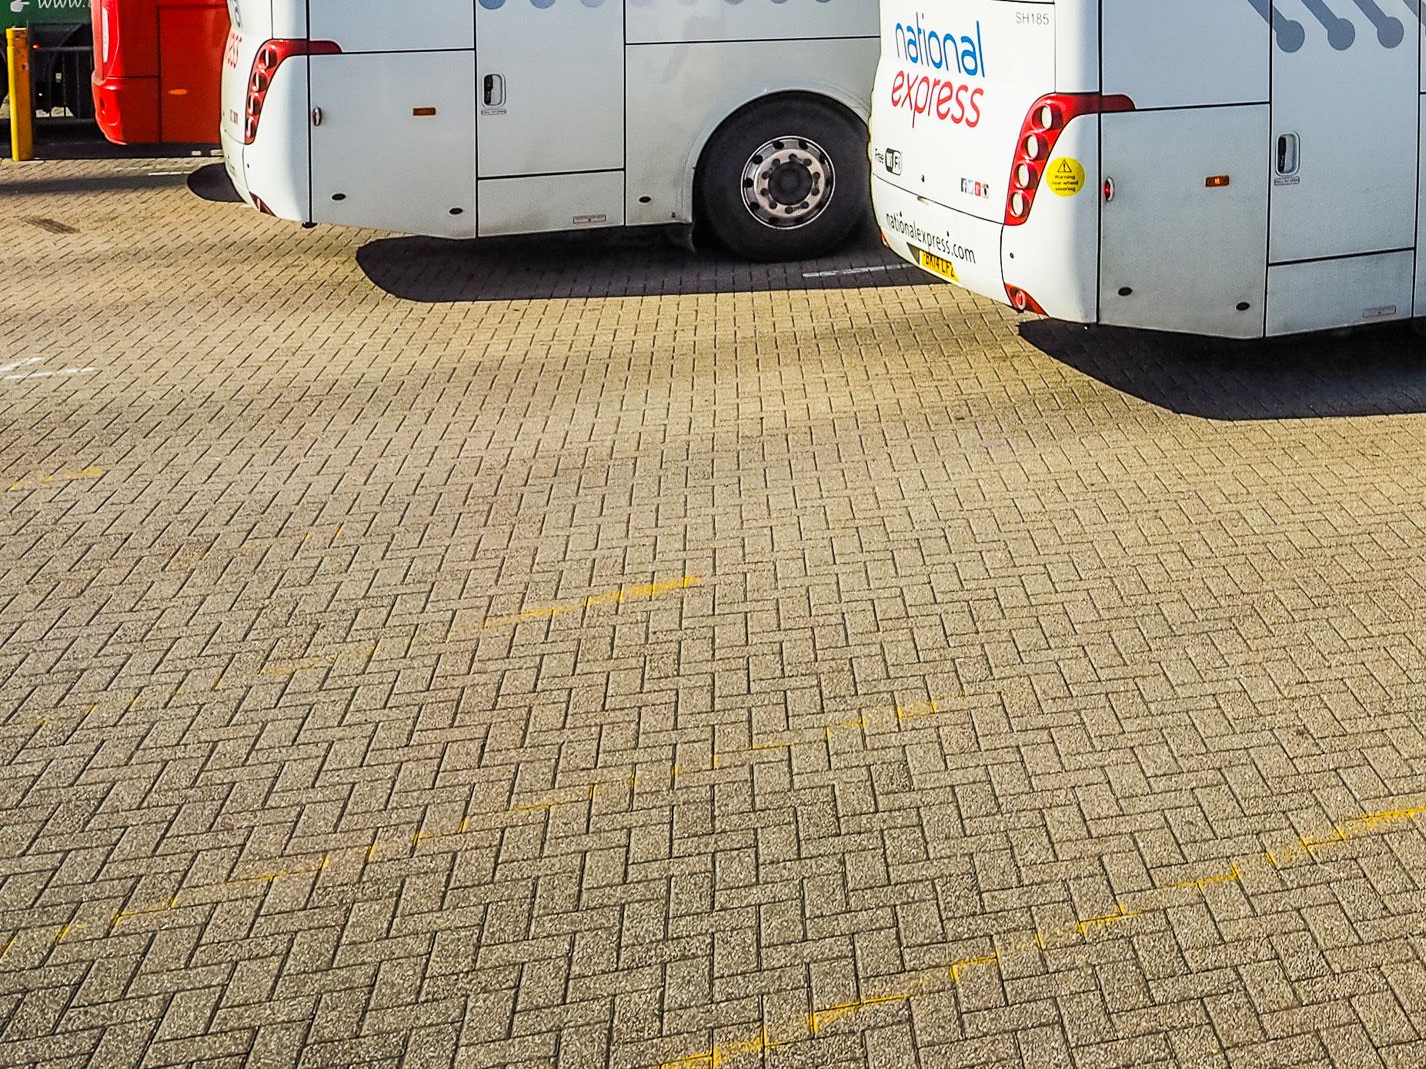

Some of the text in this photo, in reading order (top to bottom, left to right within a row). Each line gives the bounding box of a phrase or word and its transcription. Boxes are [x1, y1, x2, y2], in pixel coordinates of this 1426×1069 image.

[895, 11, 985, 78] national
[1015, 11, 1050, 26] SH185
[891, 70, 984, 129] express
[886, 210, 977, 265] nationalexpress.com
